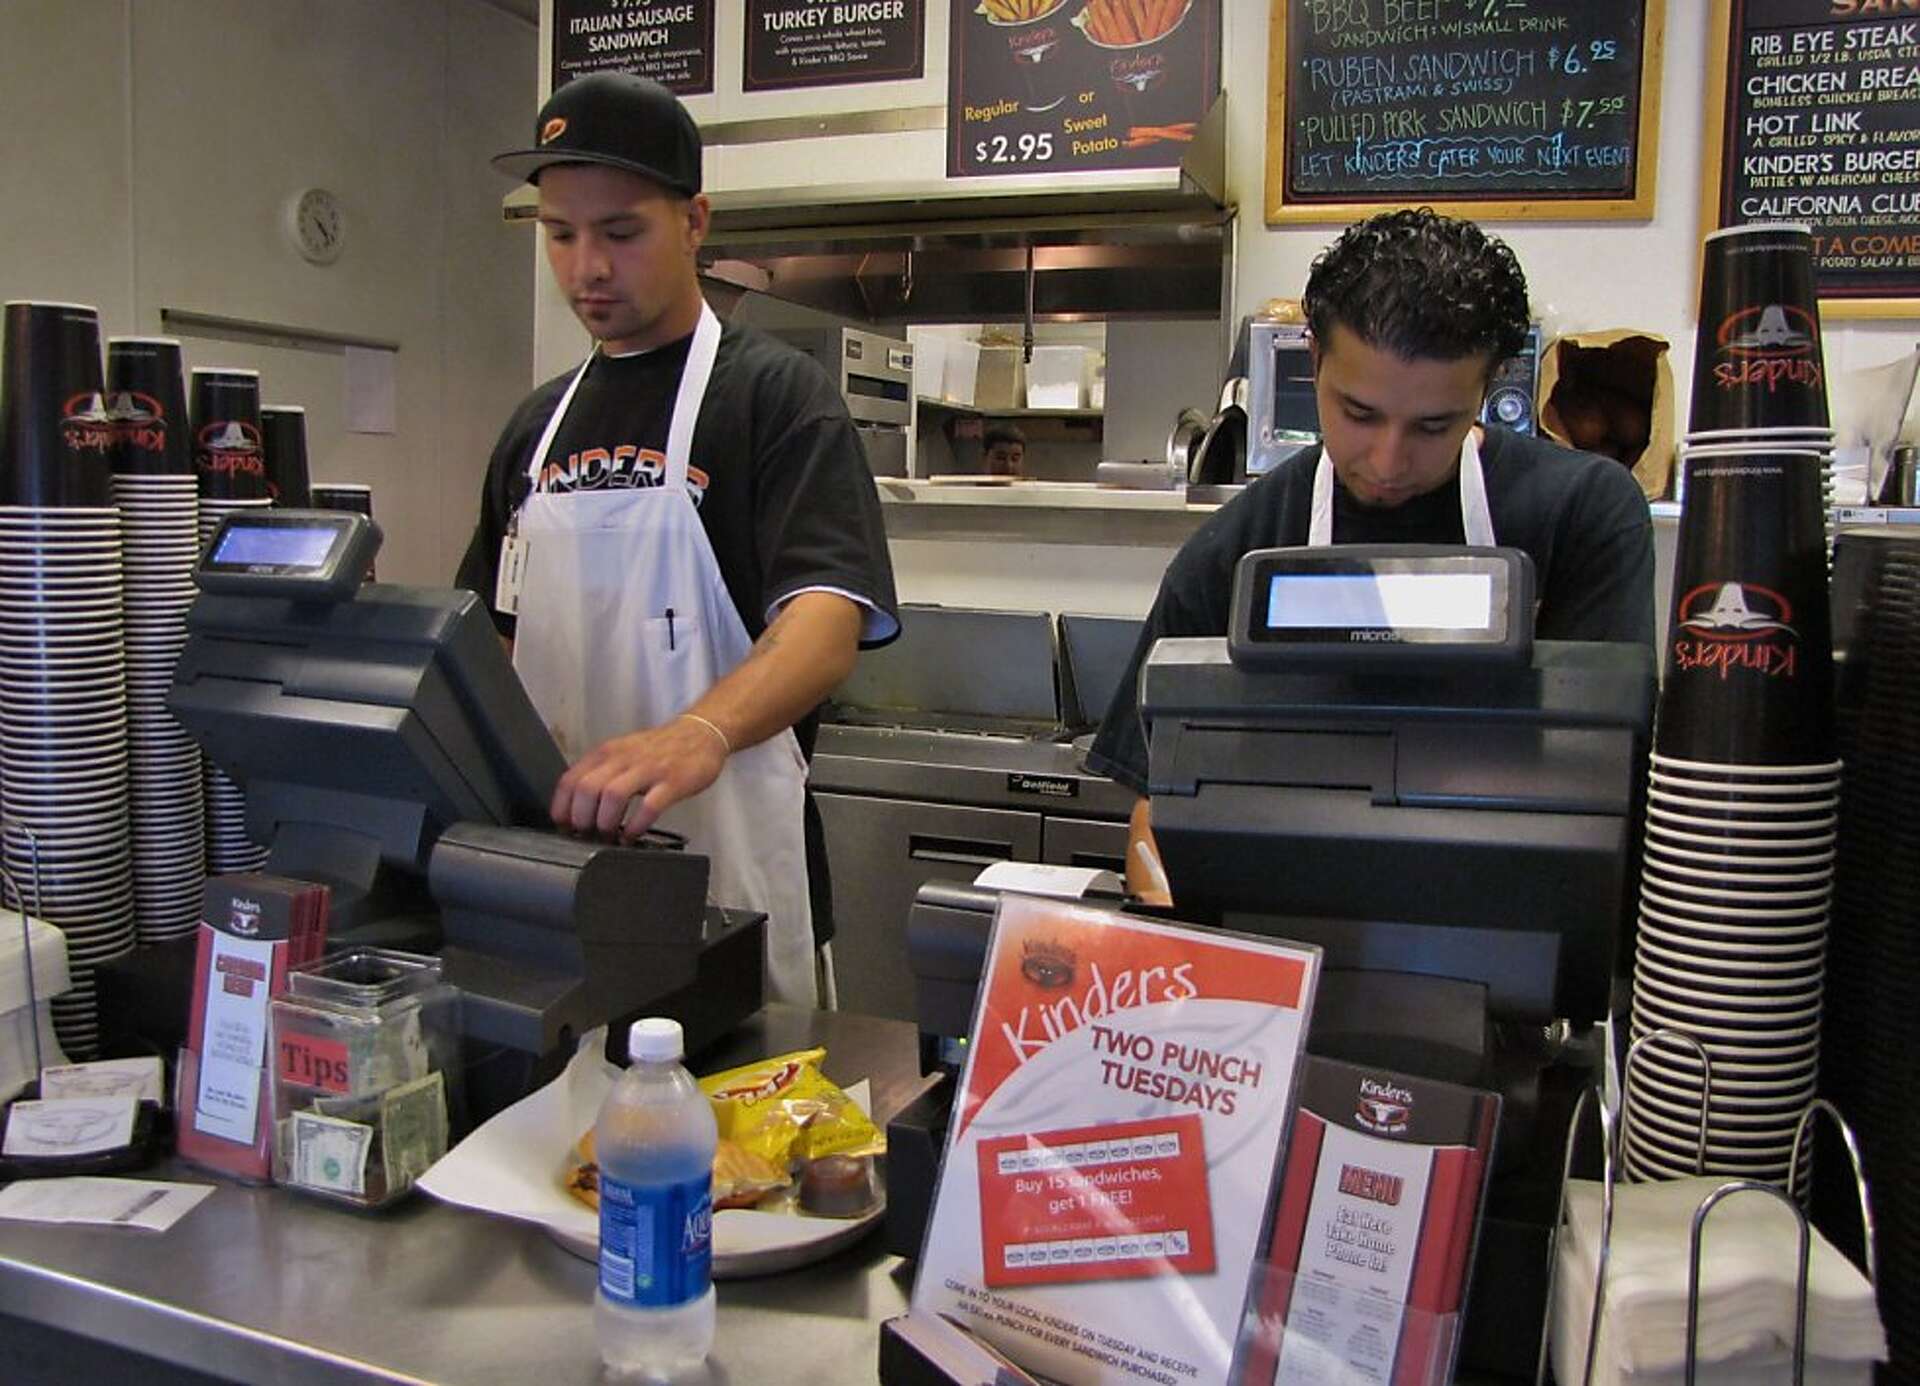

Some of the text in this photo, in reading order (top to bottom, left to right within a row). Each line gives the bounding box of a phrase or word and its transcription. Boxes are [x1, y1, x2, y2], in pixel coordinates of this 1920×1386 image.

[570, 5, 694, 34] ITALIAN SAUSAGE
[763, 1, 904, 31] TURKEY BURGER
[1312, 0, 1371, 34] BBQ
[1519, 16, 1569, 32] DRINK
[588, 28, 669, 52] SANDWICH
[1750, 23, 1917, 55] RIB EYE STEAK
[1810, 53, 1831, 64] 1/2
[1311, 54, 1395, 91] RUBEN
[1747, 66, 1920, 96] CHICKEN BREA
[1078, 90, 1095, 104] or
[1818, 91, 1872, 105] CHICKEN
[965, 99, 1020, 123] Regular
[1063, 113, 1108, 134] Sweet
[1307, 112, 1376, 148] PULLED
[1383, 108, 1427, 141] PORK
[1747, 111, 1862, 136] HOT LINK
[975, 133, 1053, 163] $2.95
[1072, 137, 1118, 156] Potato
[1752, 137, 1763, 149] A
[1823, 132, 1855, 146] SPICY
[1301, 152, 1334, 177] LET
[1428, 147, 1479, 177] CATER
[1488, 146, 1524, 165] YOUR
[1585, 146, 1631, 168] EVENT
[1744, 152, 1833, 175] KINDER'S
[1750, 175, 1795, 188] PATTIES
[1817, 173, 1876, 187] AMERICAN
[1741, 195, 1862, 216] CALIFORNIA
[1828, 235, 1845, 255] A
[1002, 962, 1199, 1064] Kinders
[282, 1041, 348, 1087] Tips
[1091, 1025, 1264, 1088] TWO PUNCH
[1101, 1060, 1238, 1116] TUESDAYS
[1015, 1178, 1043, 1194] Buy
[1048, 1175, 1065, 1190] 15
[1049, 1195, 1074, 1214] get
[1015, 1306, 1042, 1323] LOCAL
[1081, 1327, 1096, 1342] ON
[1098, 1333, 1136, 1356] TUESDAY
[1137, 1347, 1160, 1364] AND
[1026, 1325, 1043, 1339] FOR
[1044, 1330, 1071, 1349] EVERY
